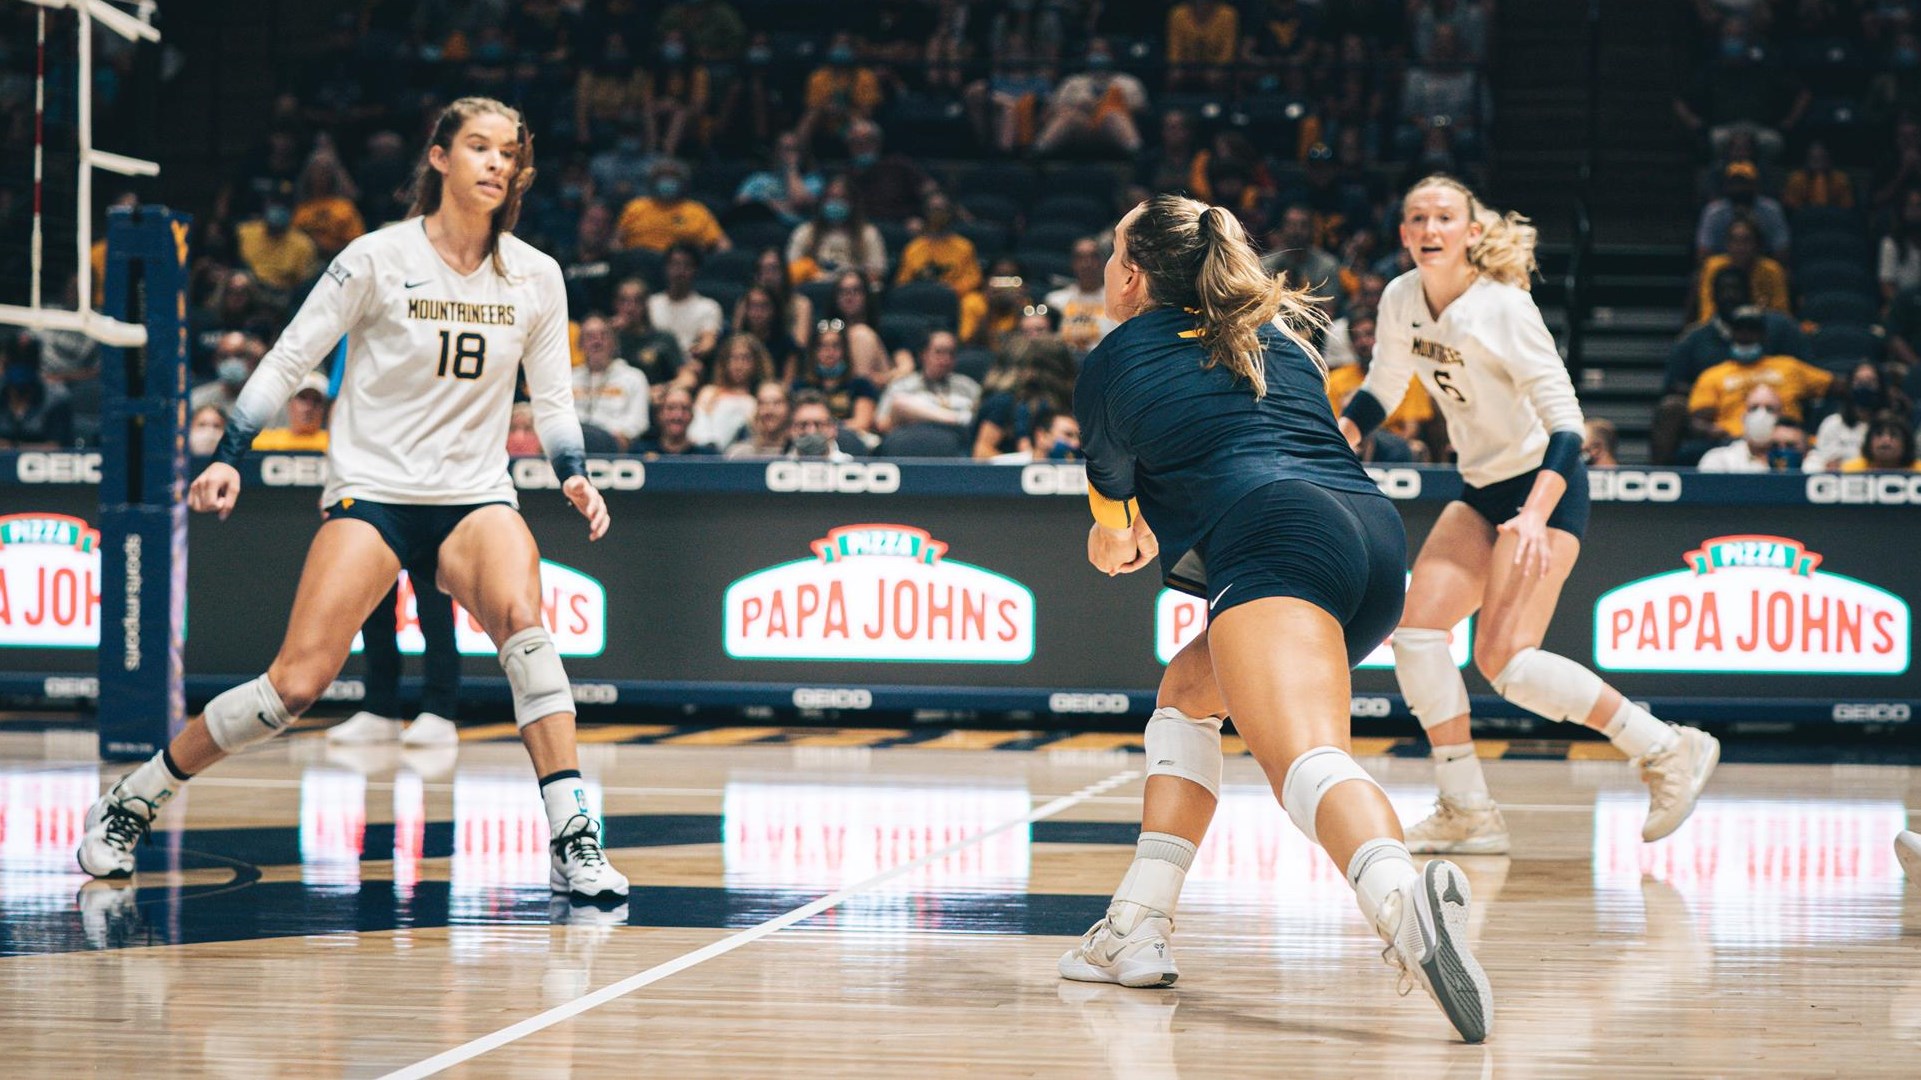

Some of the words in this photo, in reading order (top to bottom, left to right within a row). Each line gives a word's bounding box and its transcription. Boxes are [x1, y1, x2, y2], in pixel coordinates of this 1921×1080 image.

[407, 298, 515, 326] MOUNTAINEERS
[437, 330, 486, 380] 18
[17, 453, 102, 483] GEIC
[512, 458, 645, 490] GCO
[765, 461, 901, 493] GEICO
[1588, 470, 1682, 501] EICO
[847, 530, 913, 556] PIZZA
[1720, 542, 1787, 568] PIZZA
[742, 580, 849, 639] PAPA
[1612, 591, 1723, 650] PAPA
[44, 676, 100, 699] GEIC
[793, 688, 872, 709] GEICO
[1049, 692, 1130, 714] GEICO
[1832, 703, 1911, 722] GEICO
